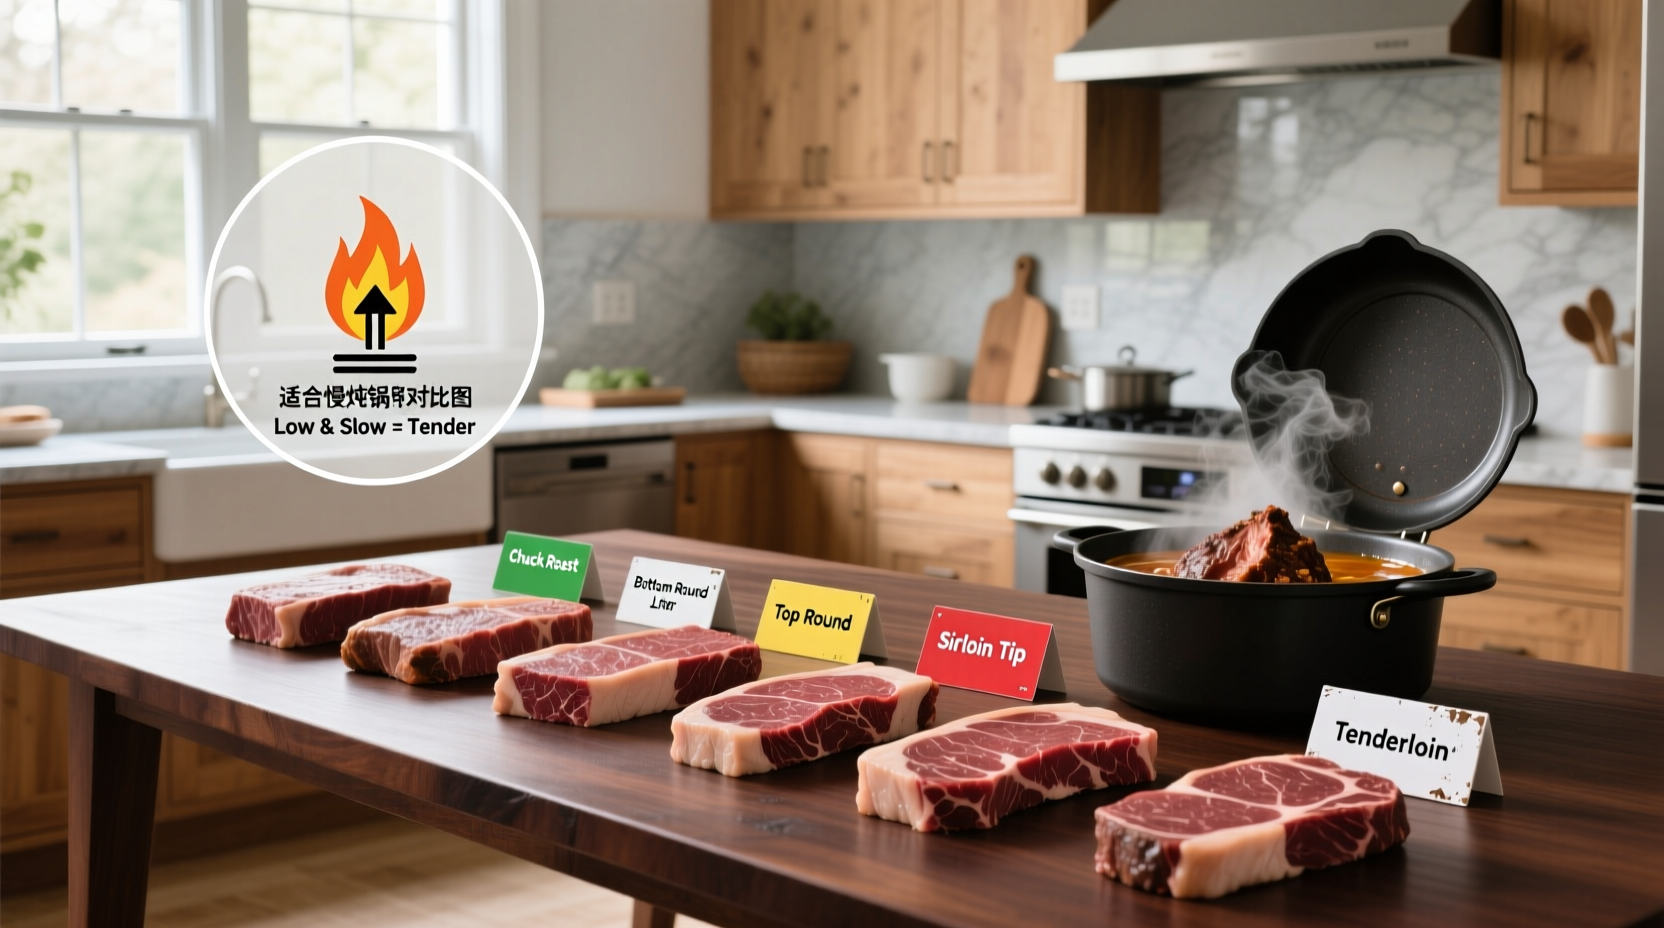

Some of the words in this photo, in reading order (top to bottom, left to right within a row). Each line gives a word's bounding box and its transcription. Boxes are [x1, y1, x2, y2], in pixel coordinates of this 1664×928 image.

[775, 603, 800, 627] Top
[803, 608, 853, 631] Round
[937, 631, 994, 658] Sirloin
[999, 640, 1027, 667] Tip
[1335, 720, 1450, 762] Tenderloin
